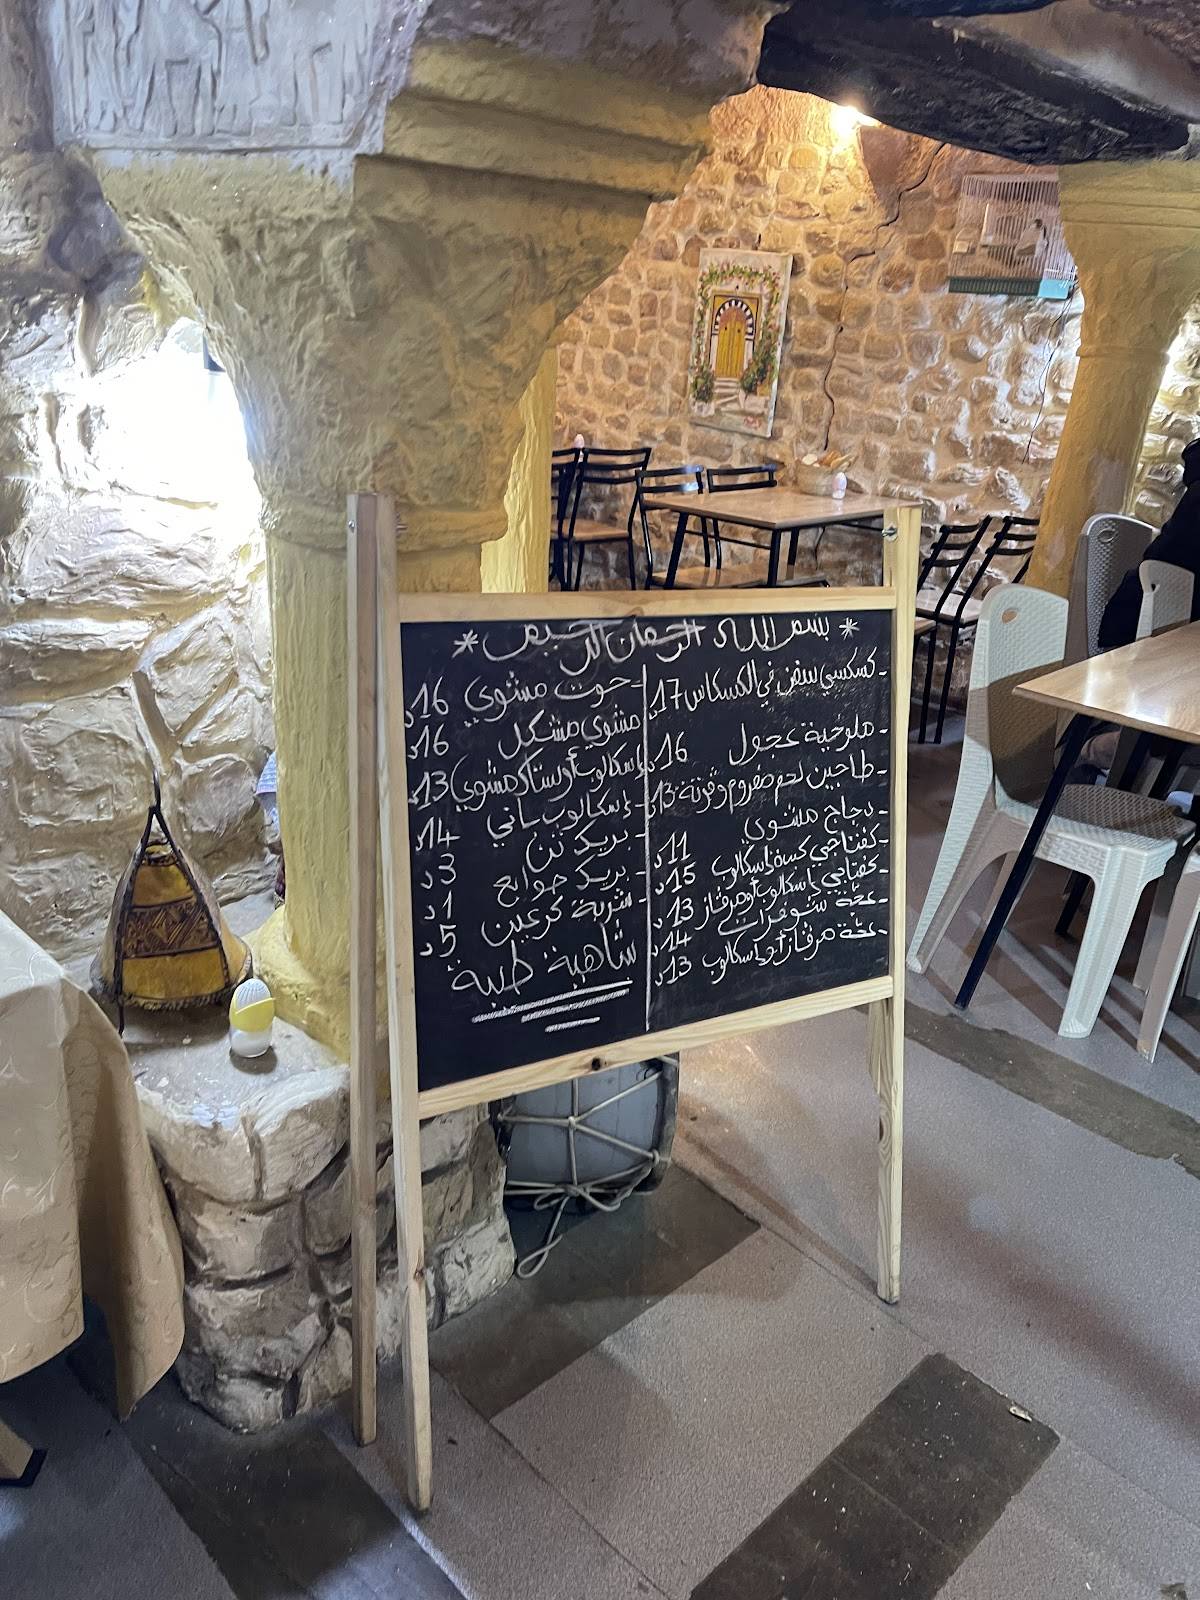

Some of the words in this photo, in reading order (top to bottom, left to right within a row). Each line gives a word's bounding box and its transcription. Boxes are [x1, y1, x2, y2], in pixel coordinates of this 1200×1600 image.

[771, 613, 831, 650] بسم
[757, 660, 775, 708] في
[821, 646, 878, 695] كسكسي
[464, 671, 547, 728] مشوي
[554, 676, 631, 708] حوت
[498, 708, 579, 760] مشكل
[581, 704, 641, 750] مشوي
[729, 722, 800, 766] عجول
[775, 760, 804, 807] لحم
[806, 749, 875, 790] طاجين
[824, 796, 873, 835] دجاج
[574, 818, 632, 857] بريك
[574, 854, 631, 891] بريك
[571, 887, 632, 924] شربة
